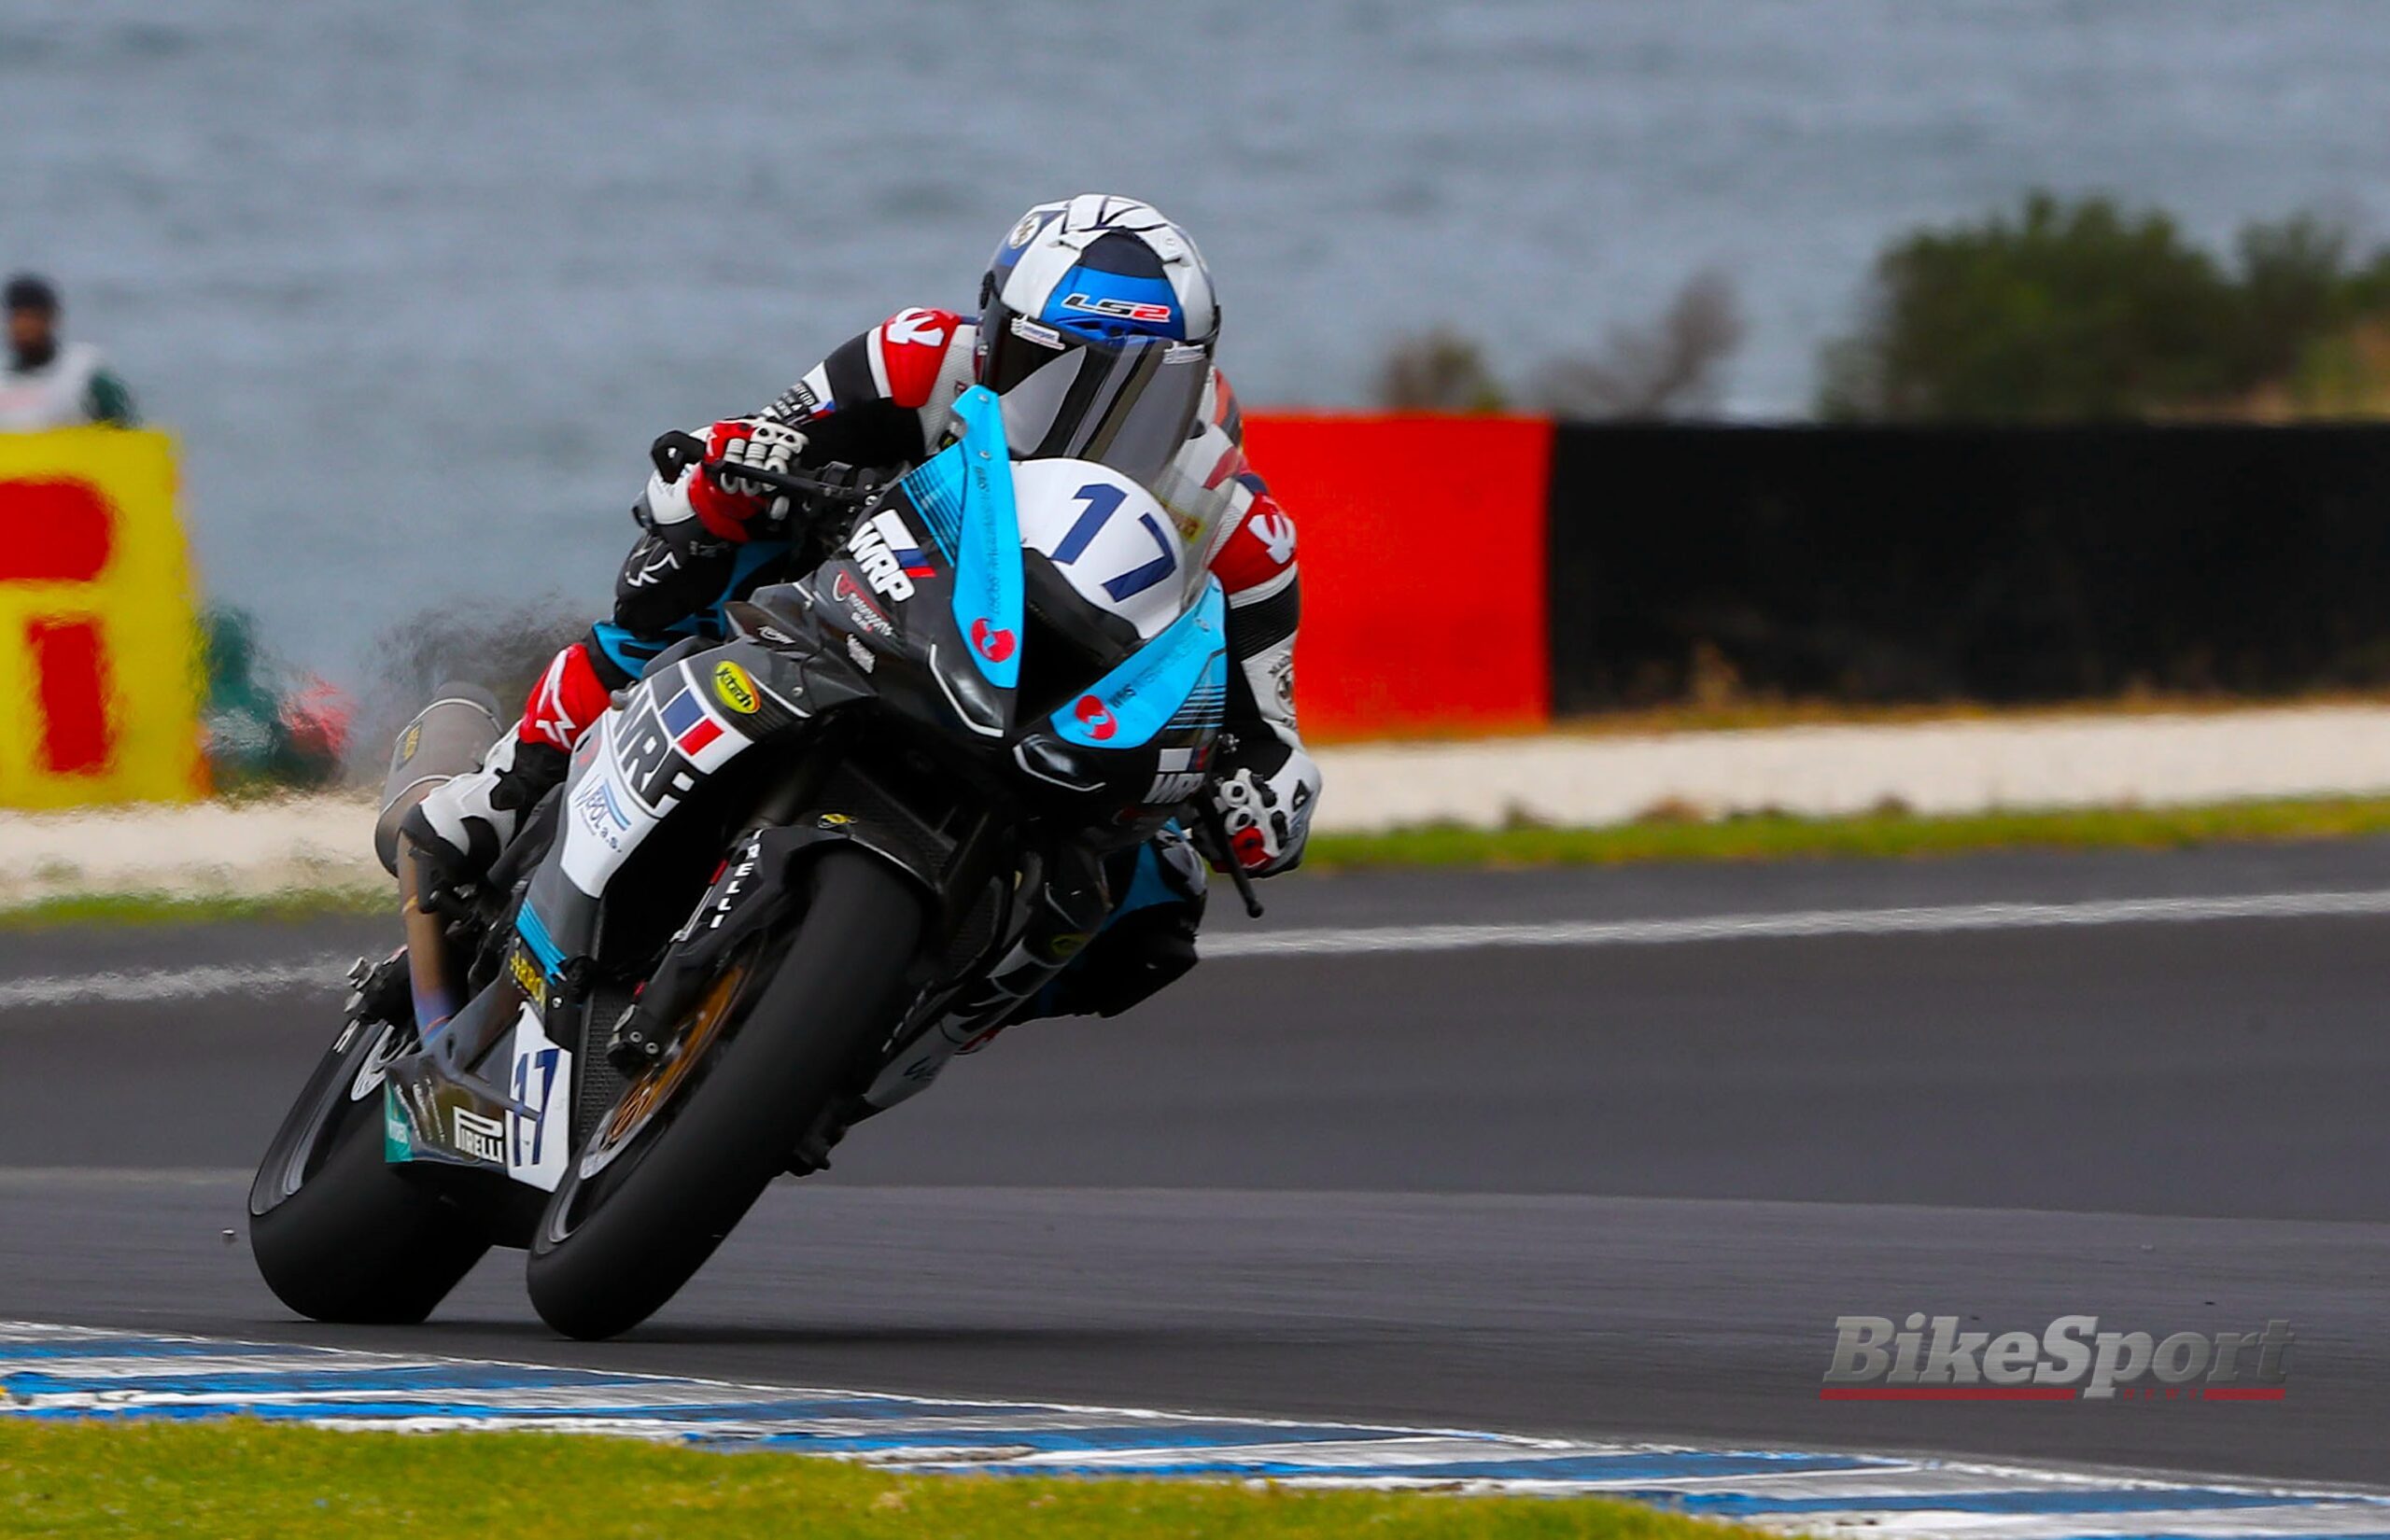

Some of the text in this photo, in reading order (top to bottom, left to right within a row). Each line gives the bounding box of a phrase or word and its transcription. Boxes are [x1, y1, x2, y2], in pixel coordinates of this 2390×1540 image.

[1061, 293, 1171, 323] LS2
[847, 520, 916, 602] WRP
[1050, 483, 1176, 603] 17
[710, 828, 764, 929] IRELLI
[453, 1105, 503, 1164] PIRELLI
[513, 1047, 560, 1168] 17
